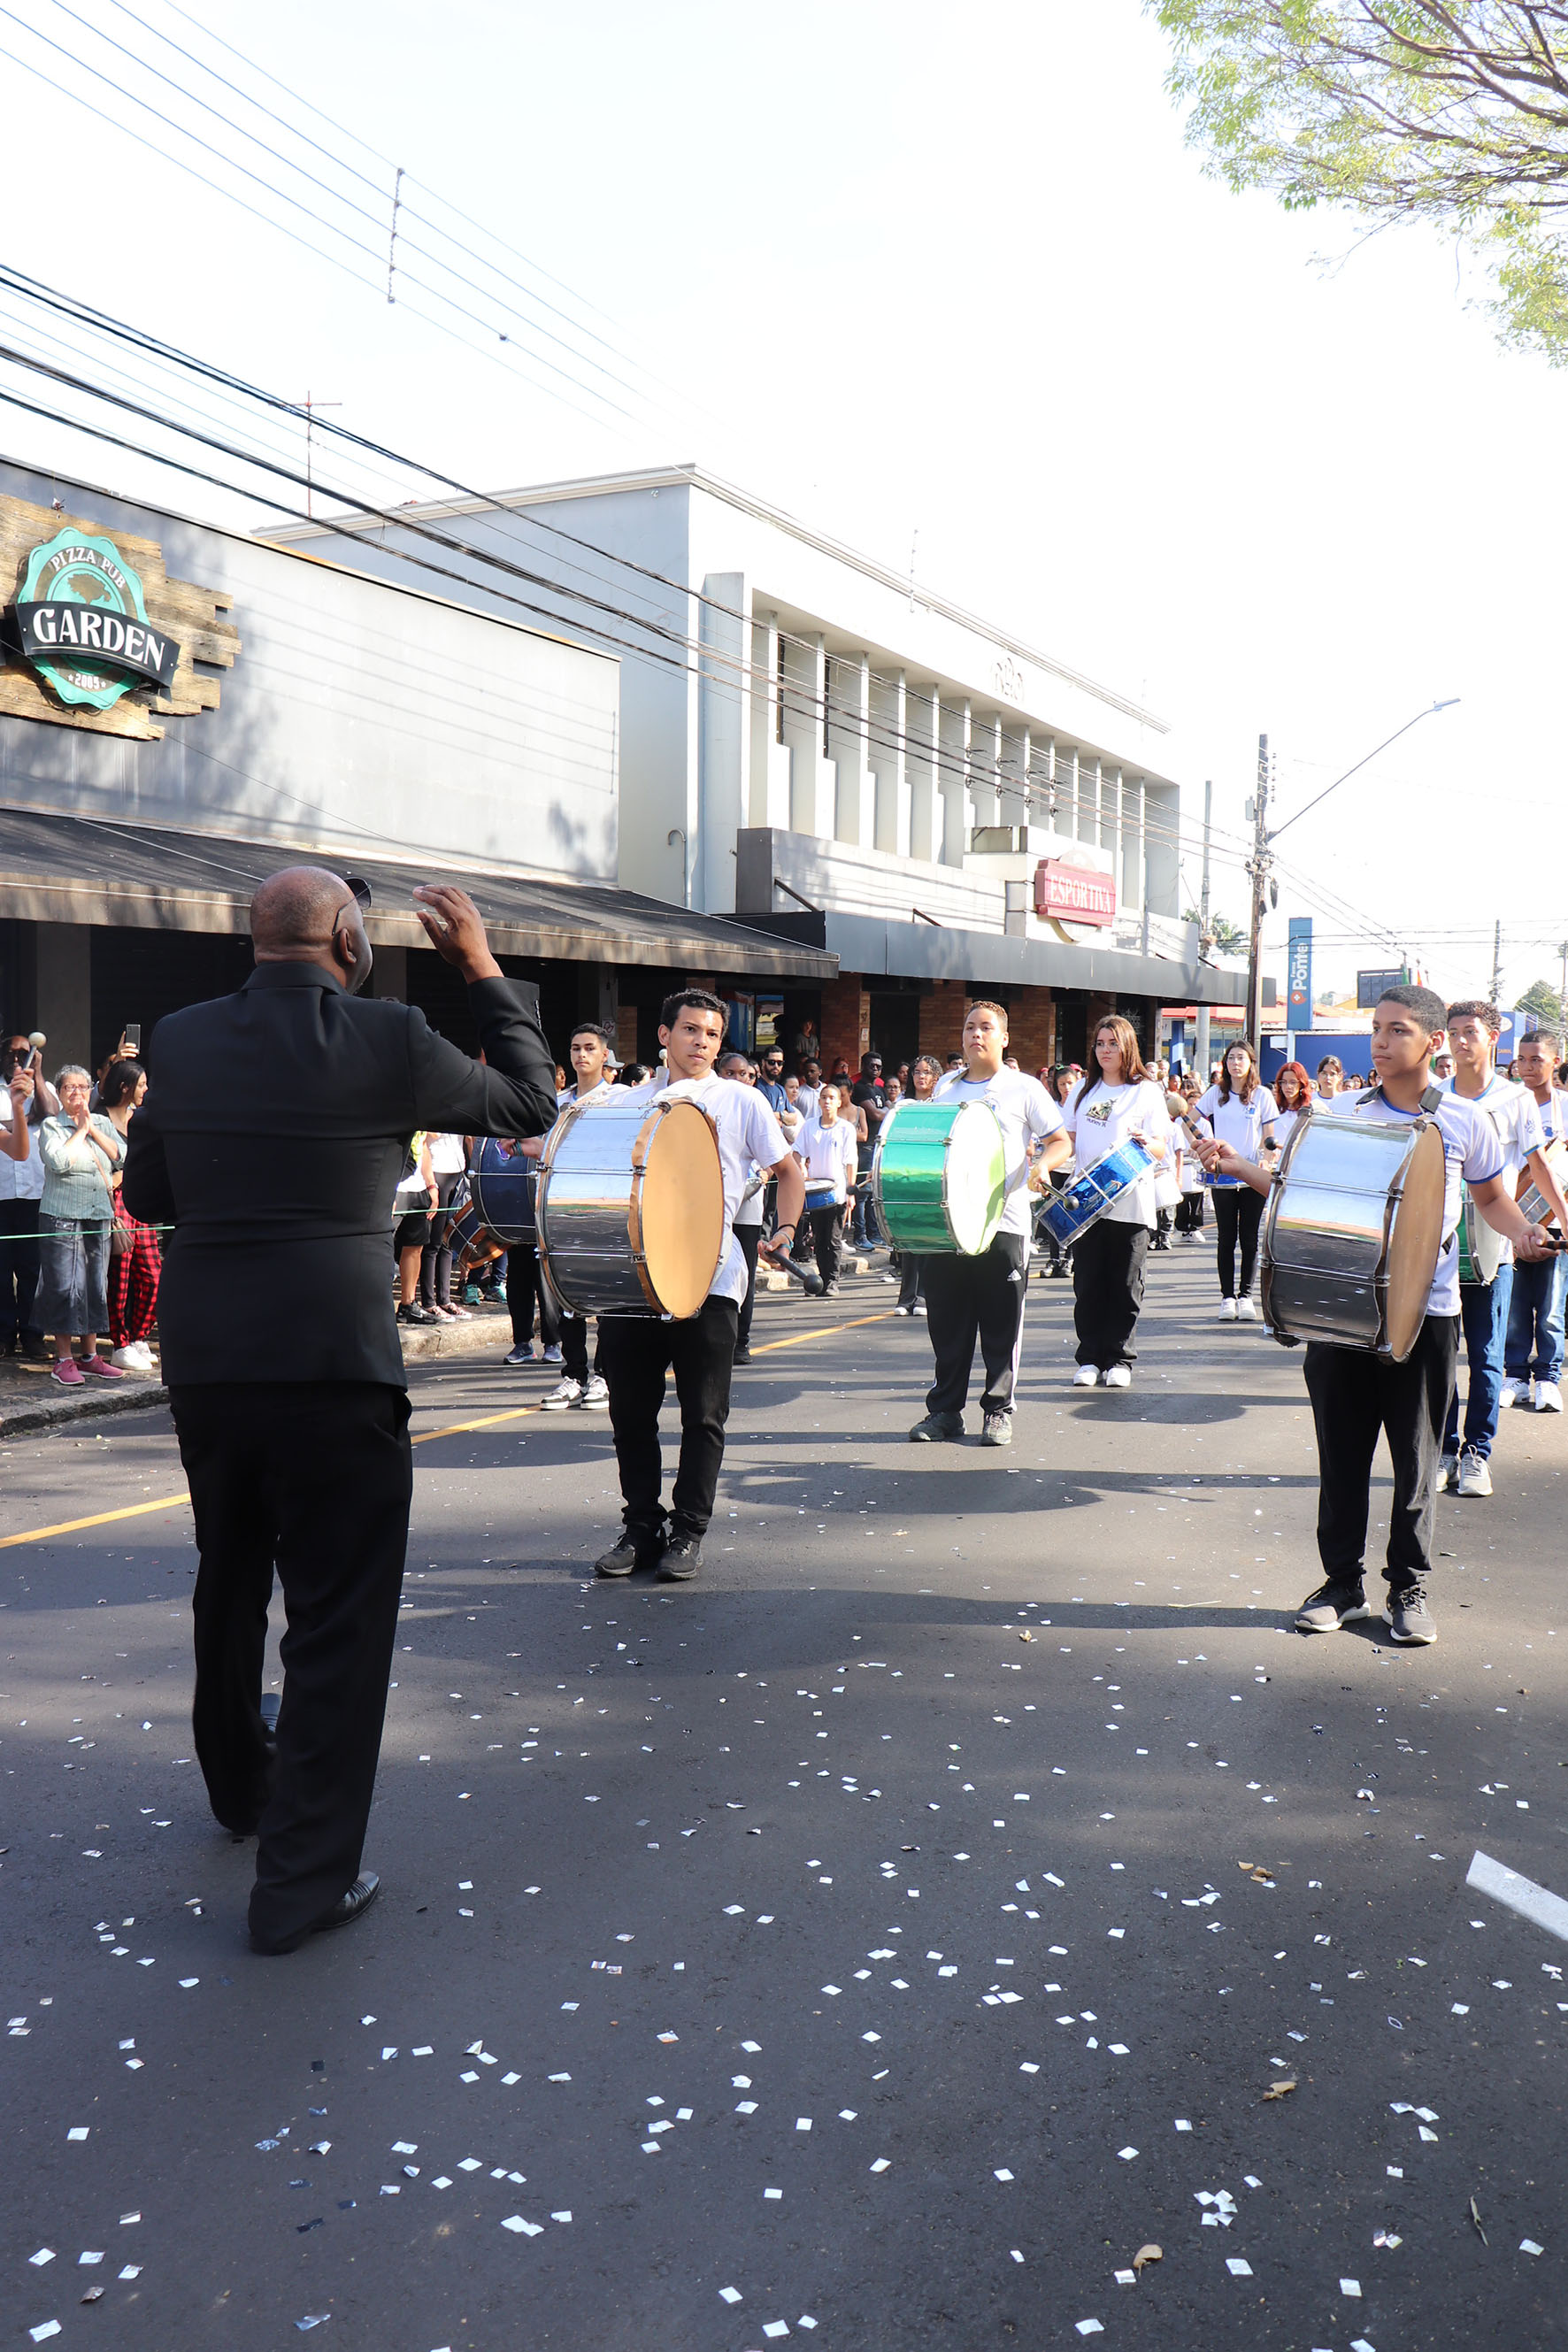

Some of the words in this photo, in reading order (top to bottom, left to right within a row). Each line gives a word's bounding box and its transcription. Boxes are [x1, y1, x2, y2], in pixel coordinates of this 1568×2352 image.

[51, 547, 96, 572] PIZZA
[101, 557, 126, 588] PUB
[34, 609, 165, 671] GARDEN
[74, 673, 100, 689] 2005
[1050, 875, 1111, 913] ESPORTIVA
[1293, 942, 1308, 990] Ponte
